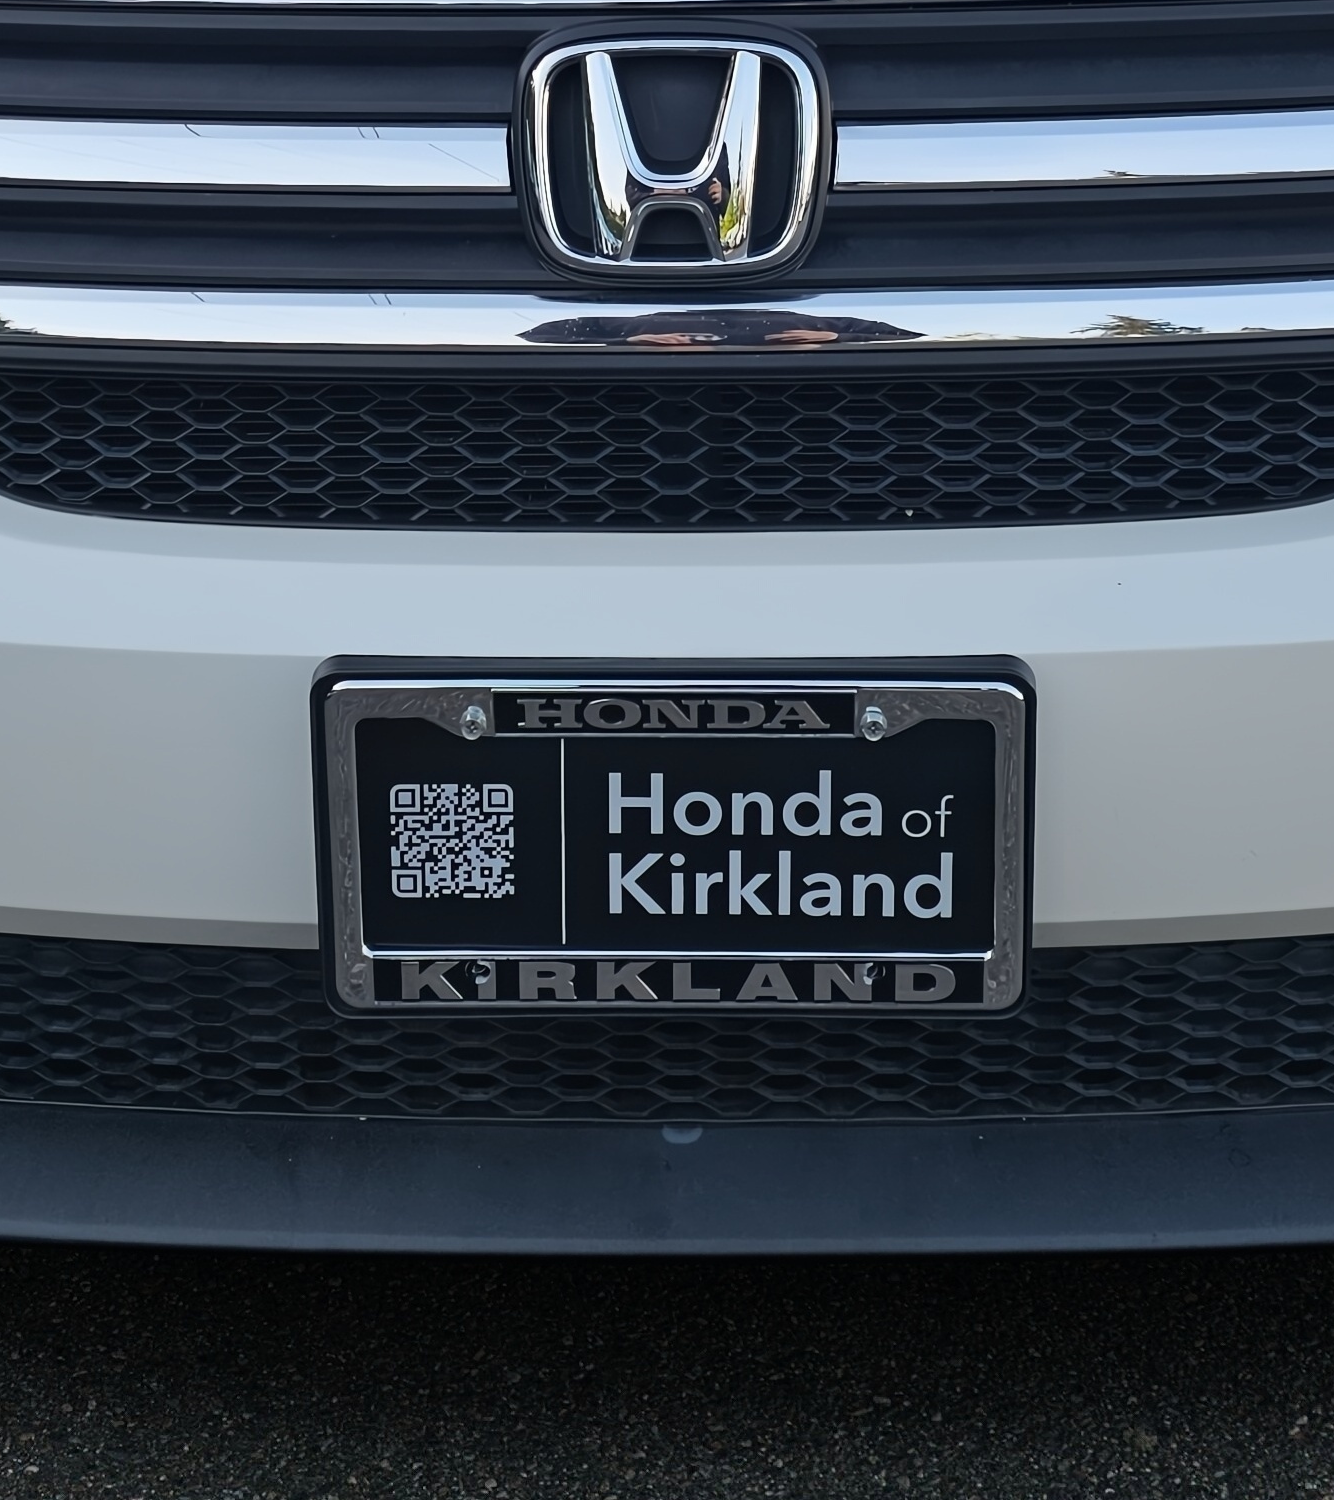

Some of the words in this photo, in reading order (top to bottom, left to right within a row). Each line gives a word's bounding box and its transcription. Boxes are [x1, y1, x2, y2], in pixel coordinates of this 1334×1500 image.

[516, 698, 831, 730] HONDA
[607, 769, 883, 838] Honda
[900, 793, 956, 840] of
[607, 850, 954, 919] Kirkland
[400, 960, 957, 1003] KIRKLAND
